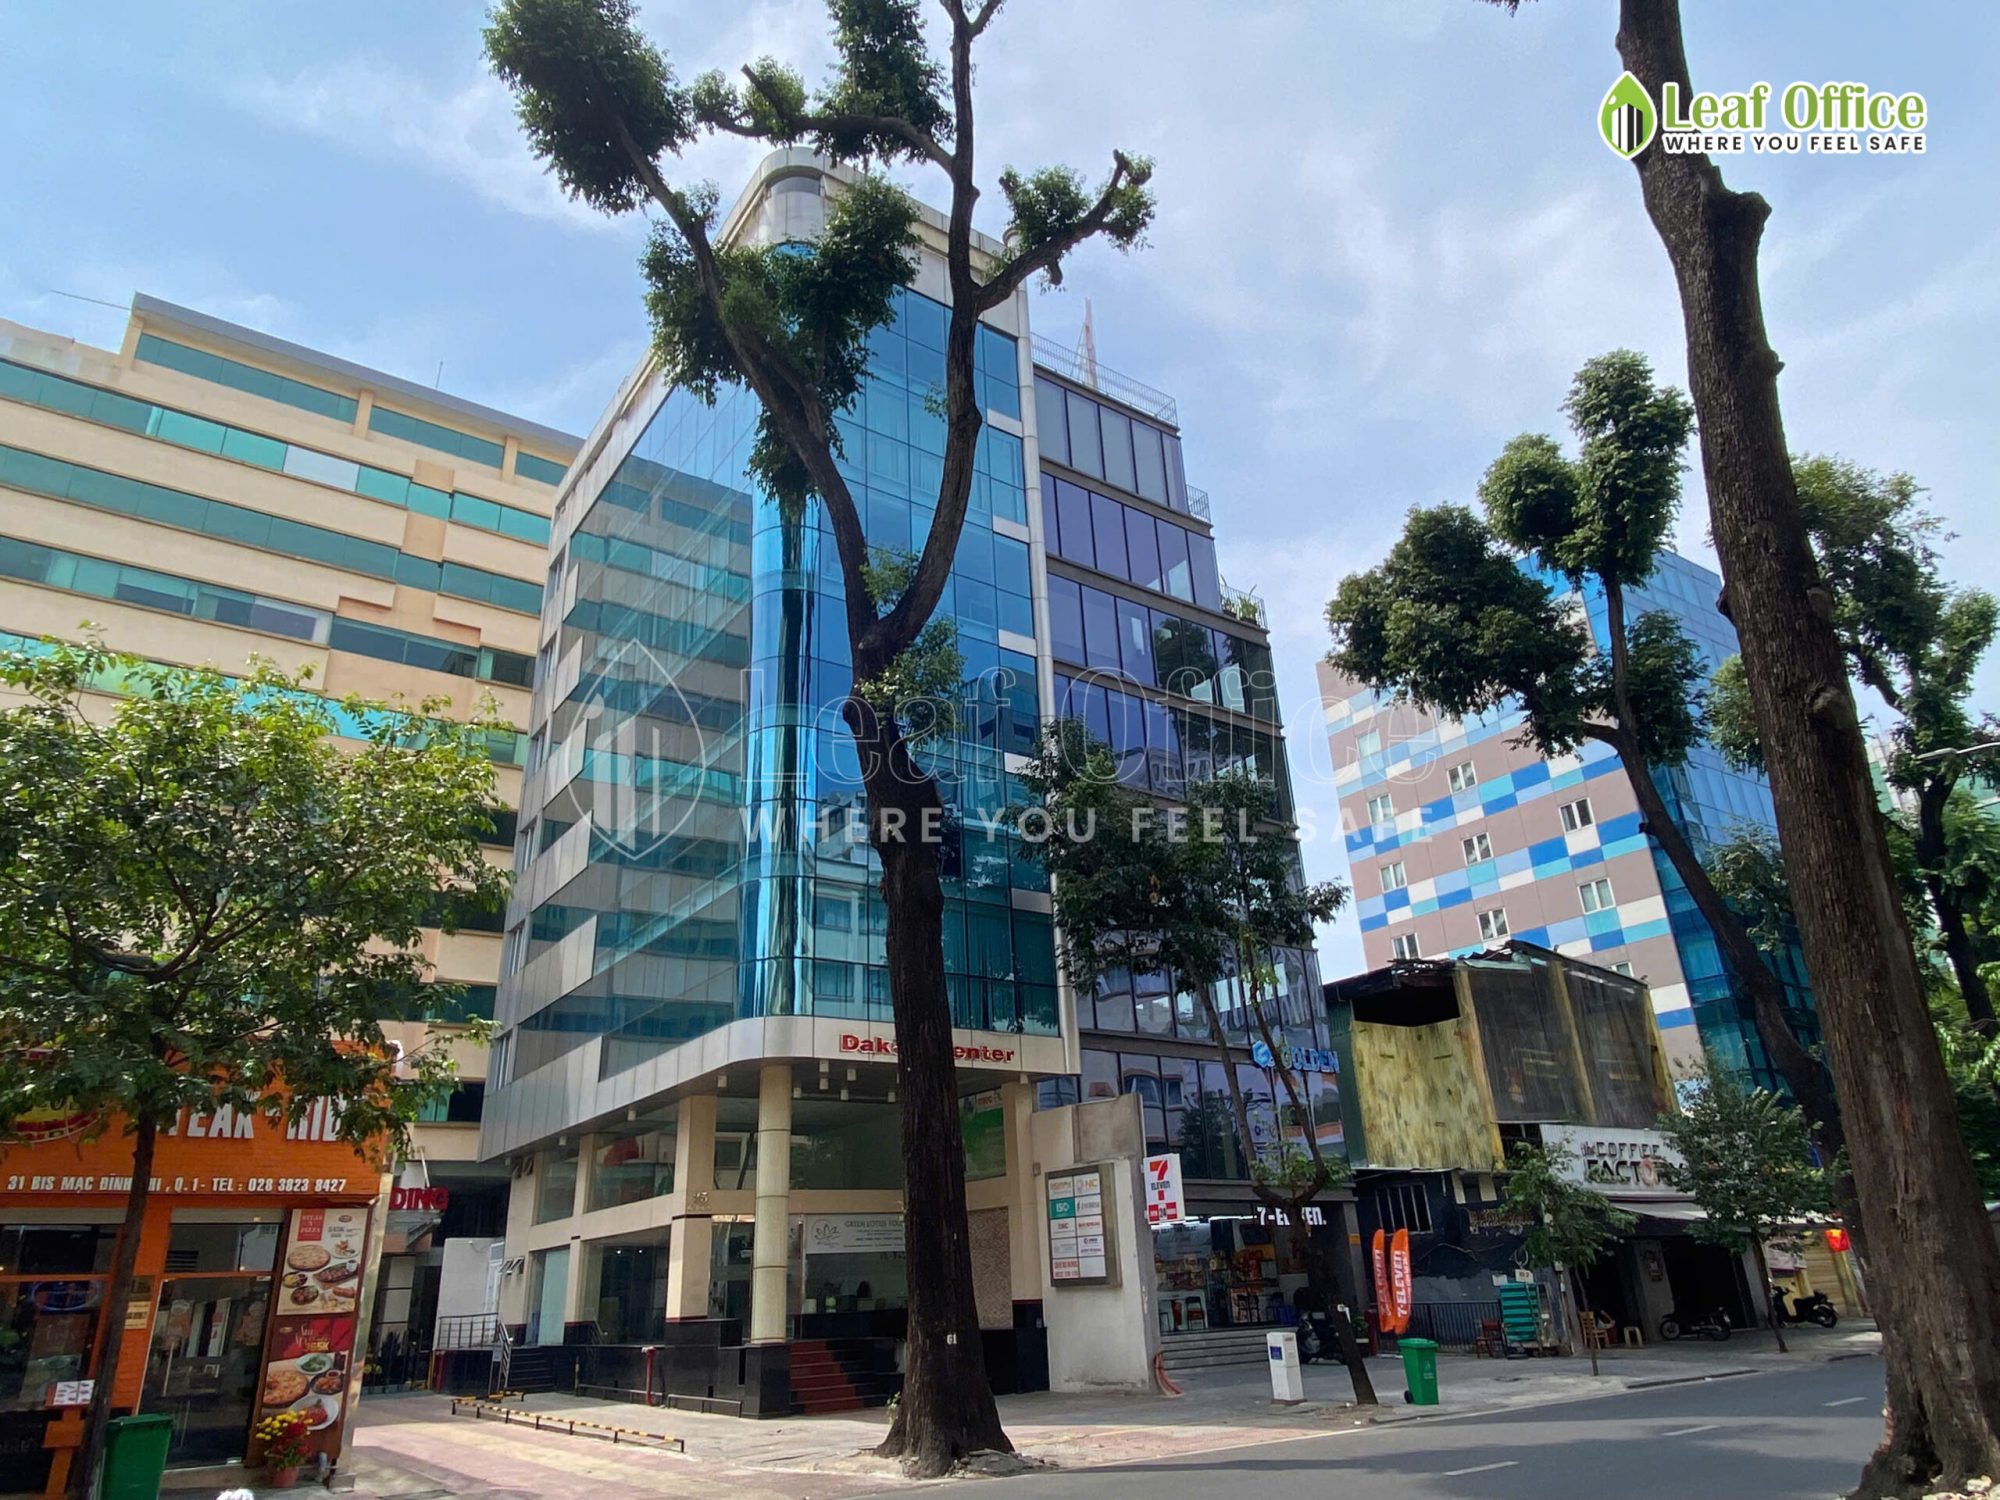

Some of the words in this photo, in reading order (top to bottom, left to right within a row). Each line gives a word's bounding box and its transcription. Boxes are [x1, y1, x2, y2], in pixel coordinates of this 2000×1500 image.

[839, 1034, 898, 1053] Dak
[953, 1045, 1015, 1062] enter
[1281, 1047, 1340, 1073] GOLDEN
[1596, 1142, 1660, 1159] COFFEE
[7, 1175, 25, 1190] 31
[31, 1175, 56, 1190] BIS
[60, 1175, 94, 1193] MẠC
[212, 1178, 234, 1191] TEL
[248, 1178, 273, 1191] 028
[278, 1178, 310, 1192] 3823
[315, 1178, 348, 1192] 8427
[1584, 1158, 1684, 1185] FACTO
